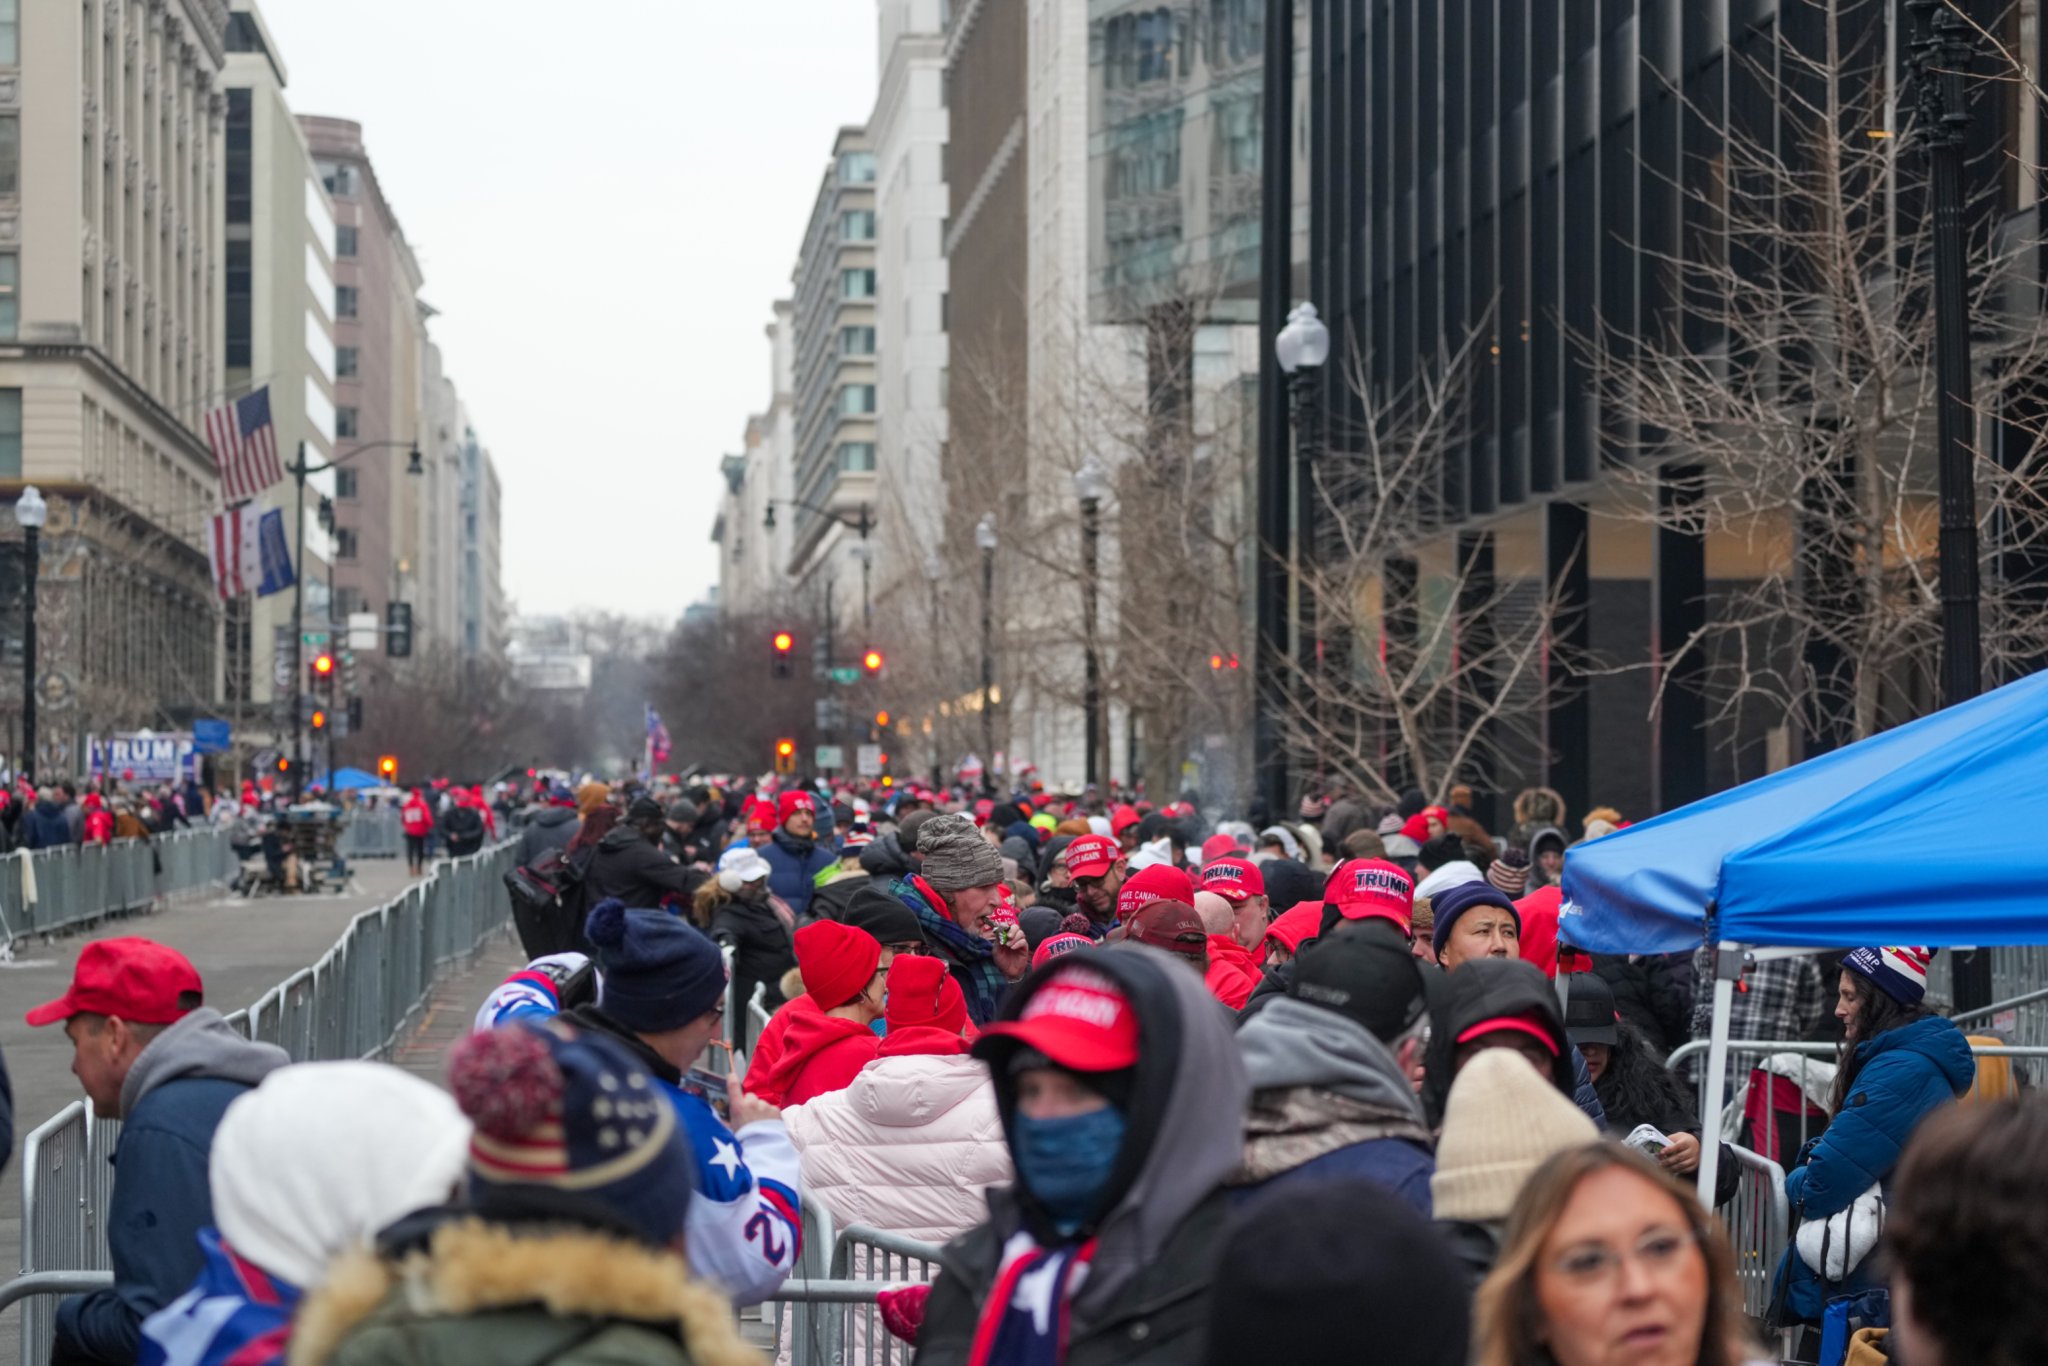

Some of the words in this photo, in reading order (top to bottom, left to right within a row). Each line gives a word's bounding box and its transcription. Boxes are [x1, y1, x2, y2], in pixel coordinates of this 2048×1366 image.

[94, 740, 192, 761] TRUMP
[1204, 866, 1244, 881] TRUMP
[1355, 872, 1410, 894] TRUMP
